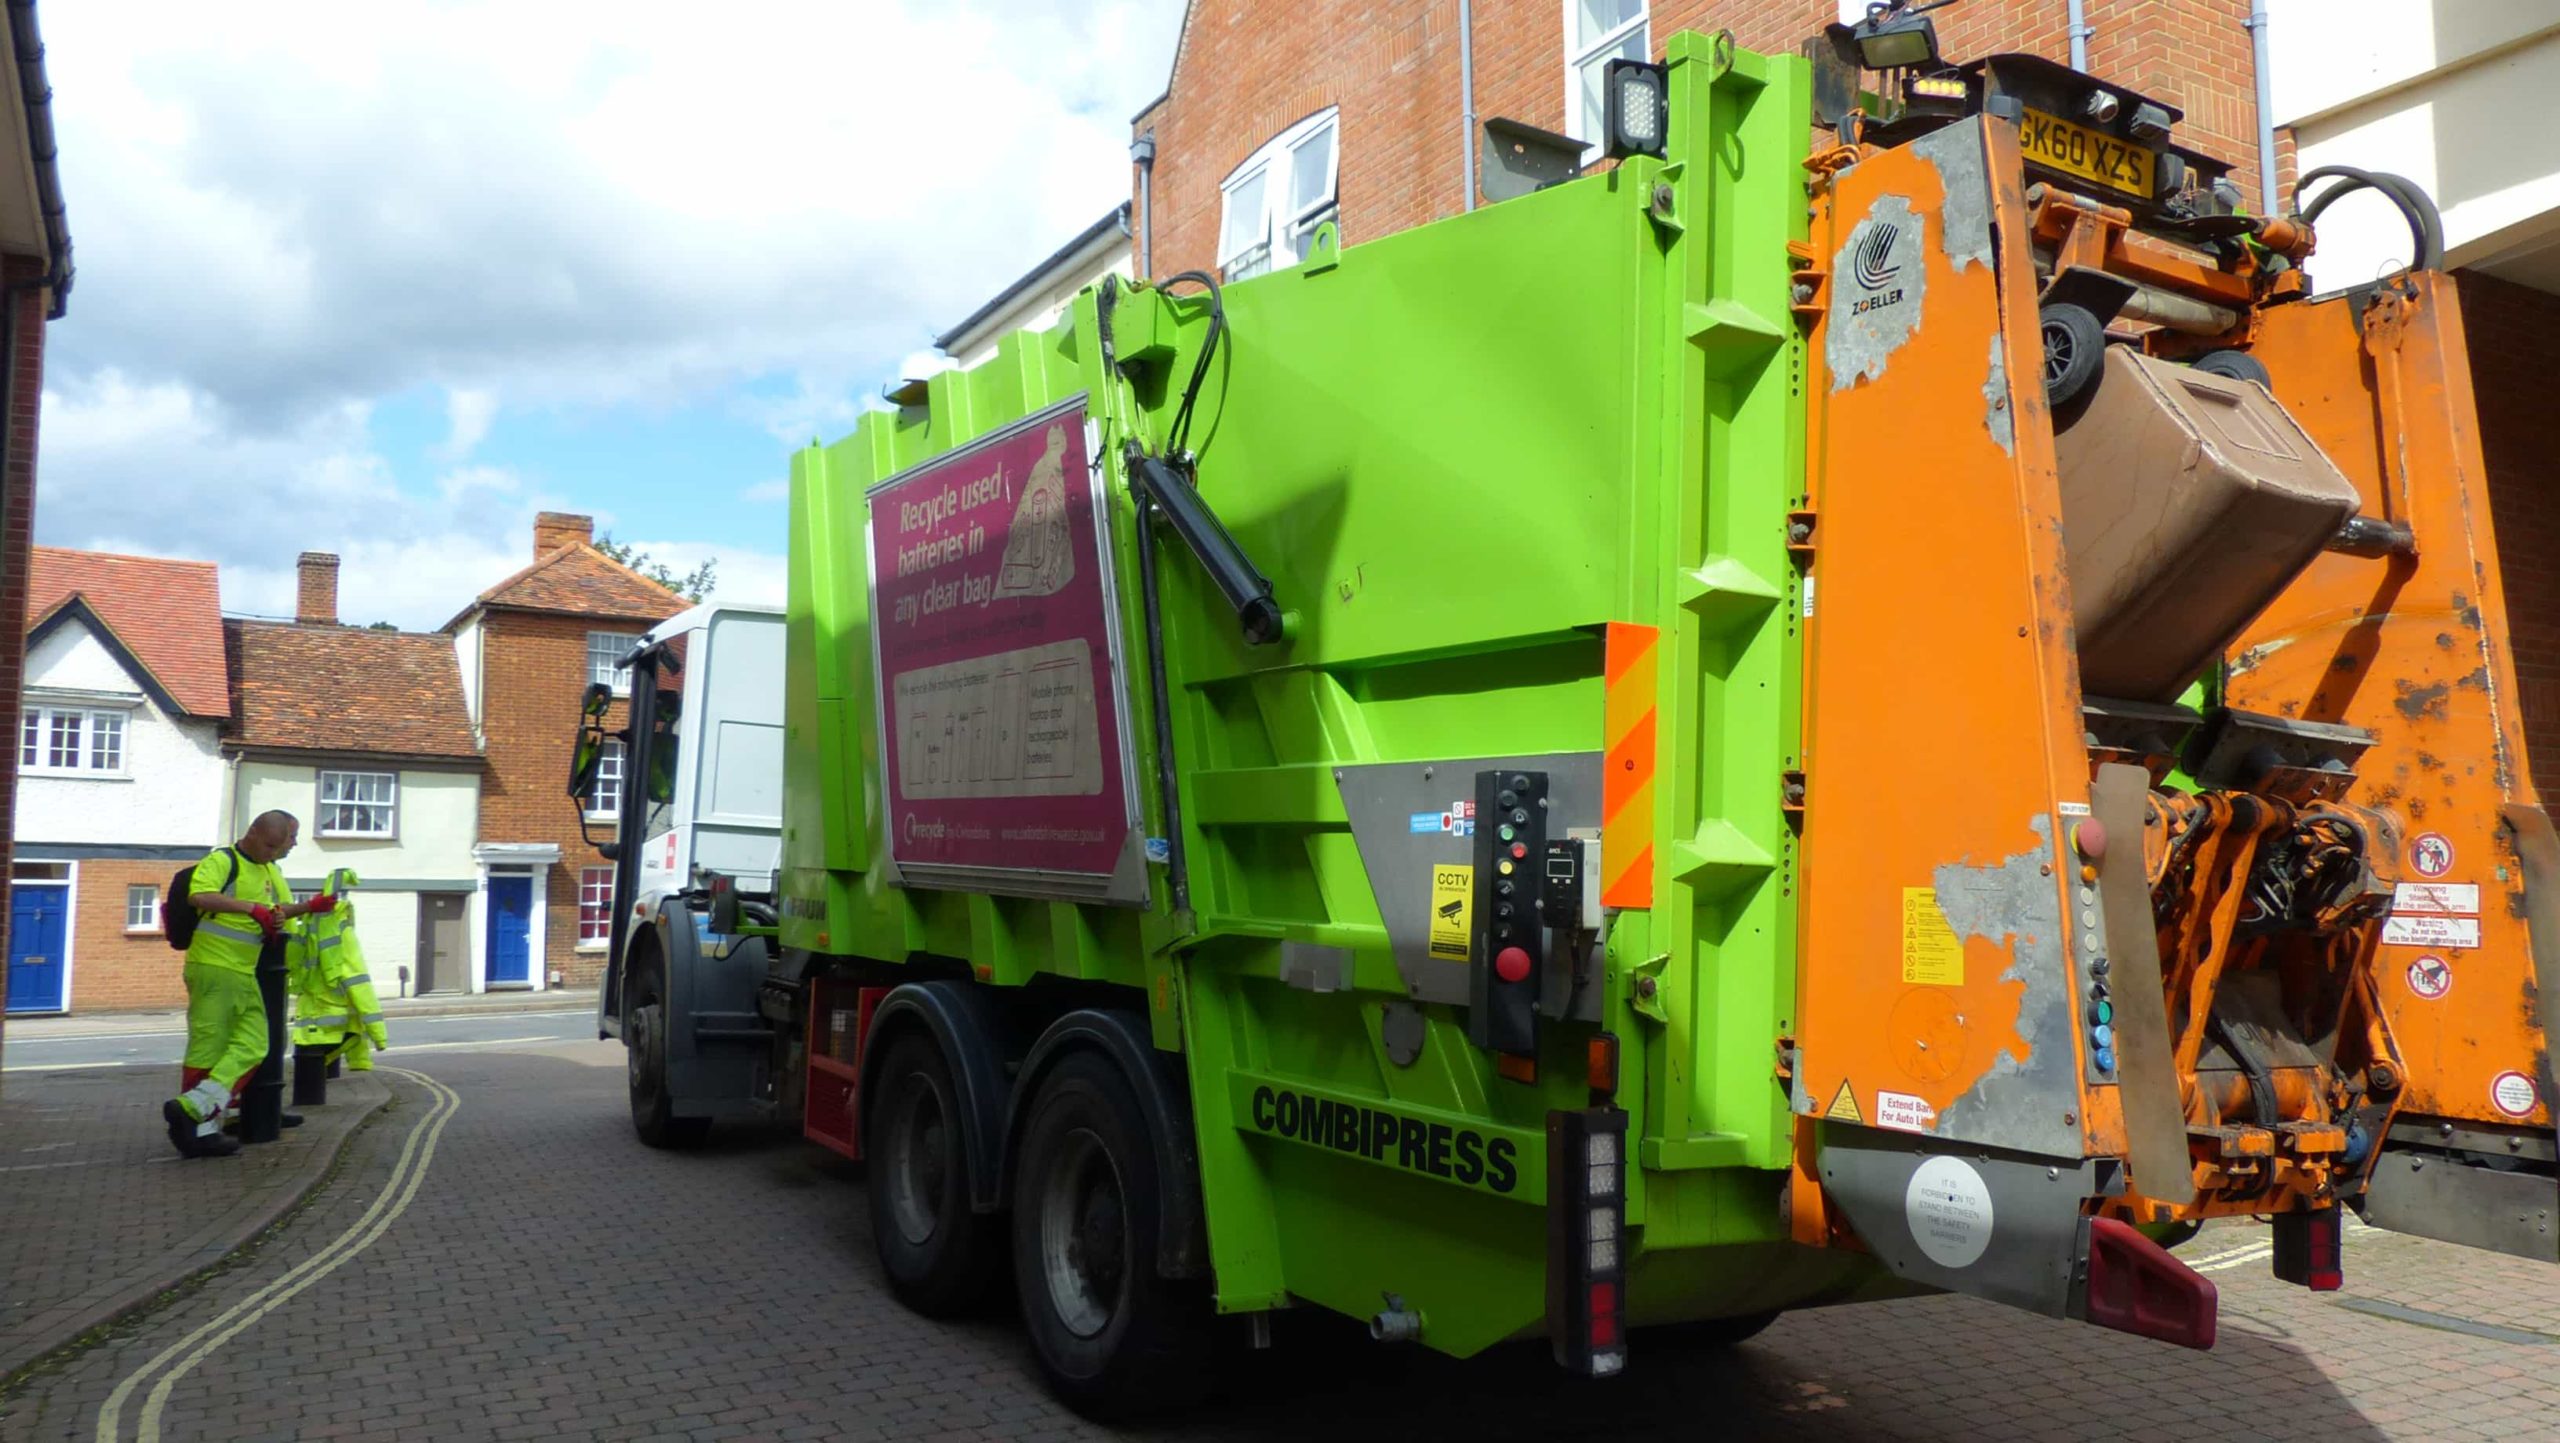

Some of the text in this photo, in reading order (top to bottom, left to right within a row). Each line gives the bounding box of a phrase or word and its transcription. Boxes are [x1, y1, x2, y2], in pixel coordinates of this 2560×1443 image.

[2019, 111, 2143, 187] GK60 XZS
[1852, 288, 1904, 317] ZOELLER
[900, 461, 1002, 535] Recycle used
[898, 520, 985, 578] batteries in
[895, 571, 992, 628] any clear bag
[1437, 872, 1469, 887] CCTV
[1887, 1097, 1914, 1111] Extend
[1882, 1110, 1894, 1121] For
[1896, 1112, 1914, 1125] Auto
[1253, 1085, 1517, 1193] COMBIPRESS
[1941, 1178, 1957, 1189] IT IS
[1921, 1187, 1976, 1206] FORBIDEN TO
[1919, 1201, 1980, 1220] STAND BETWEEN
[1927, 1215, 1941, 1226] THE
